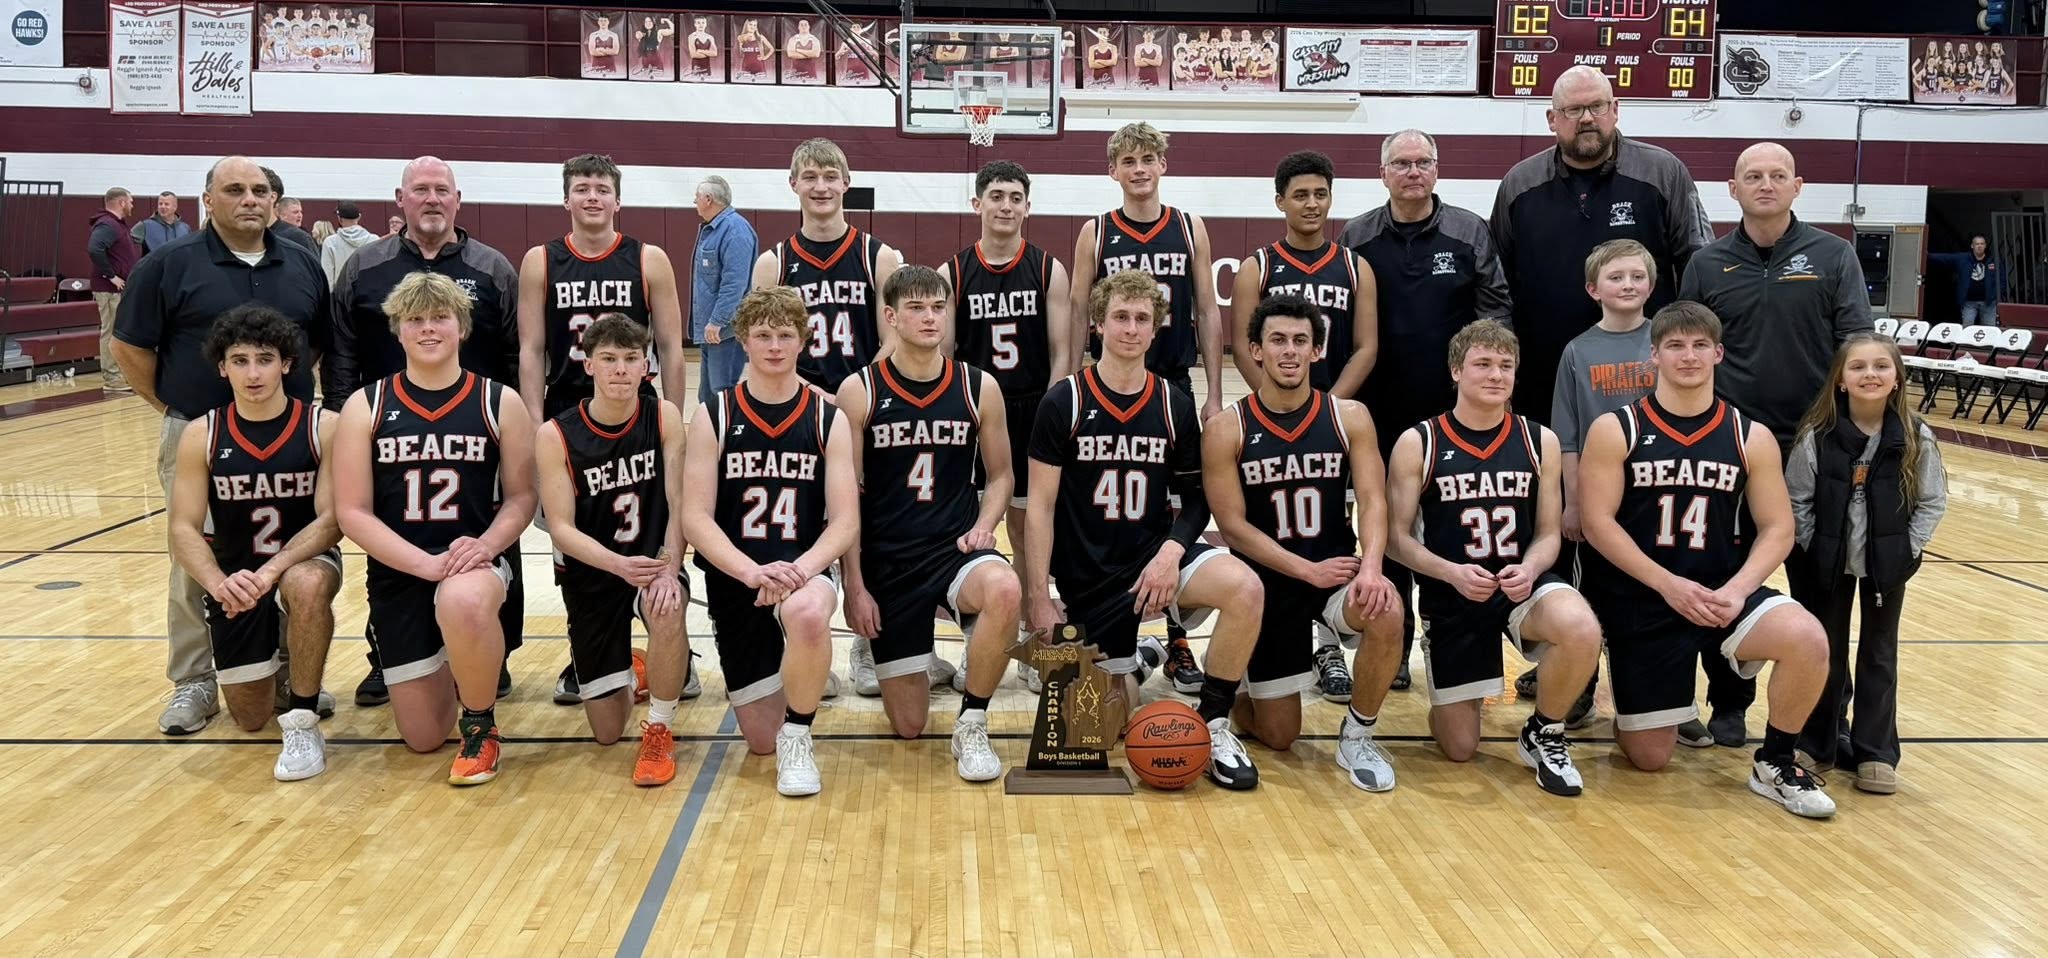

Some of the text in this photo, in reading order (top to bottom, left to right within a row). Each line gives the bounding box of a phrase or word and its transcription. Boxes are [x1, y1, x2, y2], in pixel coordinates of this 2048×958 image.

[16, 28, 44, 38] HAWKS!
[17, 18, 43, 27] GO RED
[119, 20, 173, 28] SAVE A LIFE
[191, 21, 215, 29] SAVE
[217, 21, 225, 29] A
[1514, 5, 1548, 33] 62
[1671, 8, 1705, 36] 64
[189, 50, 244, 75] Hills &
[1294, 39, 1342, 60] CASS CITY
[1514, 54, 1538, 63] FOULS
[1574, 55, 1640, 65] PLAYER FOULS
[1670, 57, 1695, 66] FOULS
[192, 68, 244, 93] Dales
[1298, 64, 1349, 84] WRESTLING
[1512, 66, 1537, 86] 00
[1619, 68, 1632, 87] 0
[1669, 68, 1694, 87] 00
[1104, 253, 1187, 278] BEACH
[556, 281, 632, 308] BEACH
[968, 290, 1037, 320] BEACH
[569, 313, 615, 361] 3
[807, 311, 855, 358] 34
[991, 322, 1019, 370] 5
[1590, 361, 1655, 390] PIRATES
[871, 419, 971, 448] BEACH
[377, 433, 488, 464] BEACH
[1077, 435, 1168, 464] BEACH
[583, 450, 656, 496] BEACH
[725, 450, 818, 481] BEACH
[906, 452, 935, 501] 4
[1241, 452, 1343, 486] BEACH
[1631, 458, 1740, 493] BEACH
[213, 470, 316, 501] BEACH
[403, 468, 461, 521] 12
[1093, 469, 1149, 521] 40
[1435, 471, 1533, 502] BEACH
[613, 492, 641, 543] 3
[741, 486, 798, 540] 24
[1270, 486, 1323, 541] 10
[1656, 494, 1710, 551] 14
[250, 506, 283, 555] 2
[1460, 505, 1519, 560] 32
[1046, 681, 1059, 748] CHAMPION
[1143, 718, 1196, 740] Rawlings
[1082, 736, 1102, 744] 2026
[1038, 752, 1100, 762] Boys Basketball
